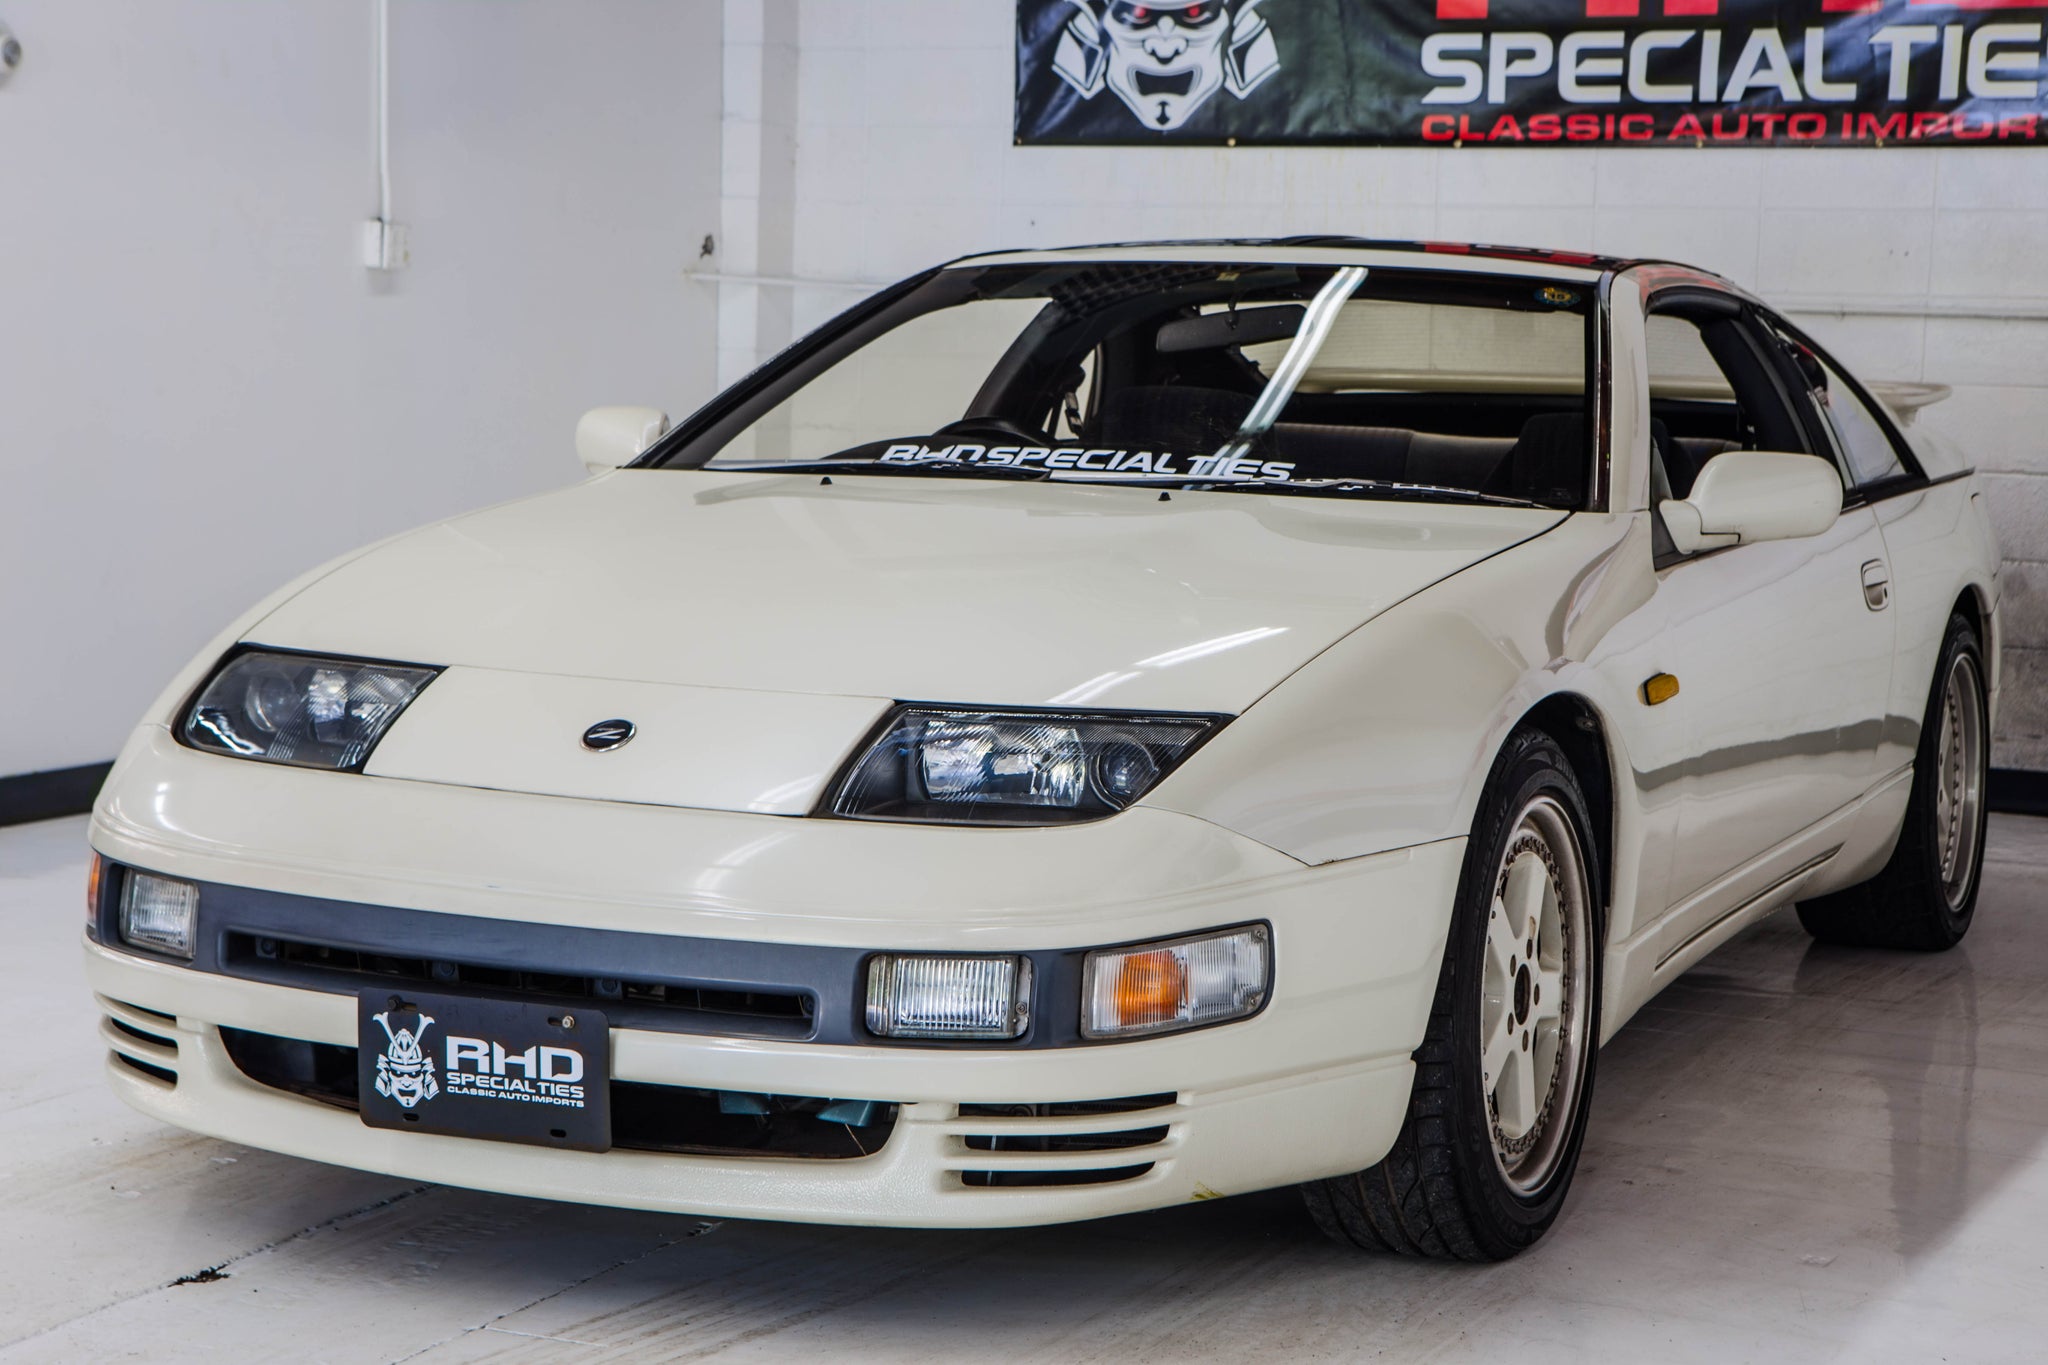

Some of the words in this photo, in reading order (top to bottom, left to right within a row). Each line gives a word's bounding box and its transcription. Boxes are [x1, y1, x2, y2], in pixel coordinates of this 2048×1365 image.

[1420, 22, 2048, 104] SPECIALTIE
[1421, 113, 1655, 141] CLASSIC
[1667, 112, 1828, 141] AUTO
[1840, 111, 2047, 140] IMPOR
[446, 1035, 585, 1083] RHD
[446, 1071, 585, 1099] SPECIALTIES
[446, 1085, 497, 1098] CLASSIC
[497, 1090, 531, 1102] AUTO
[531, 1094, 585, 1108] IMPORTS
